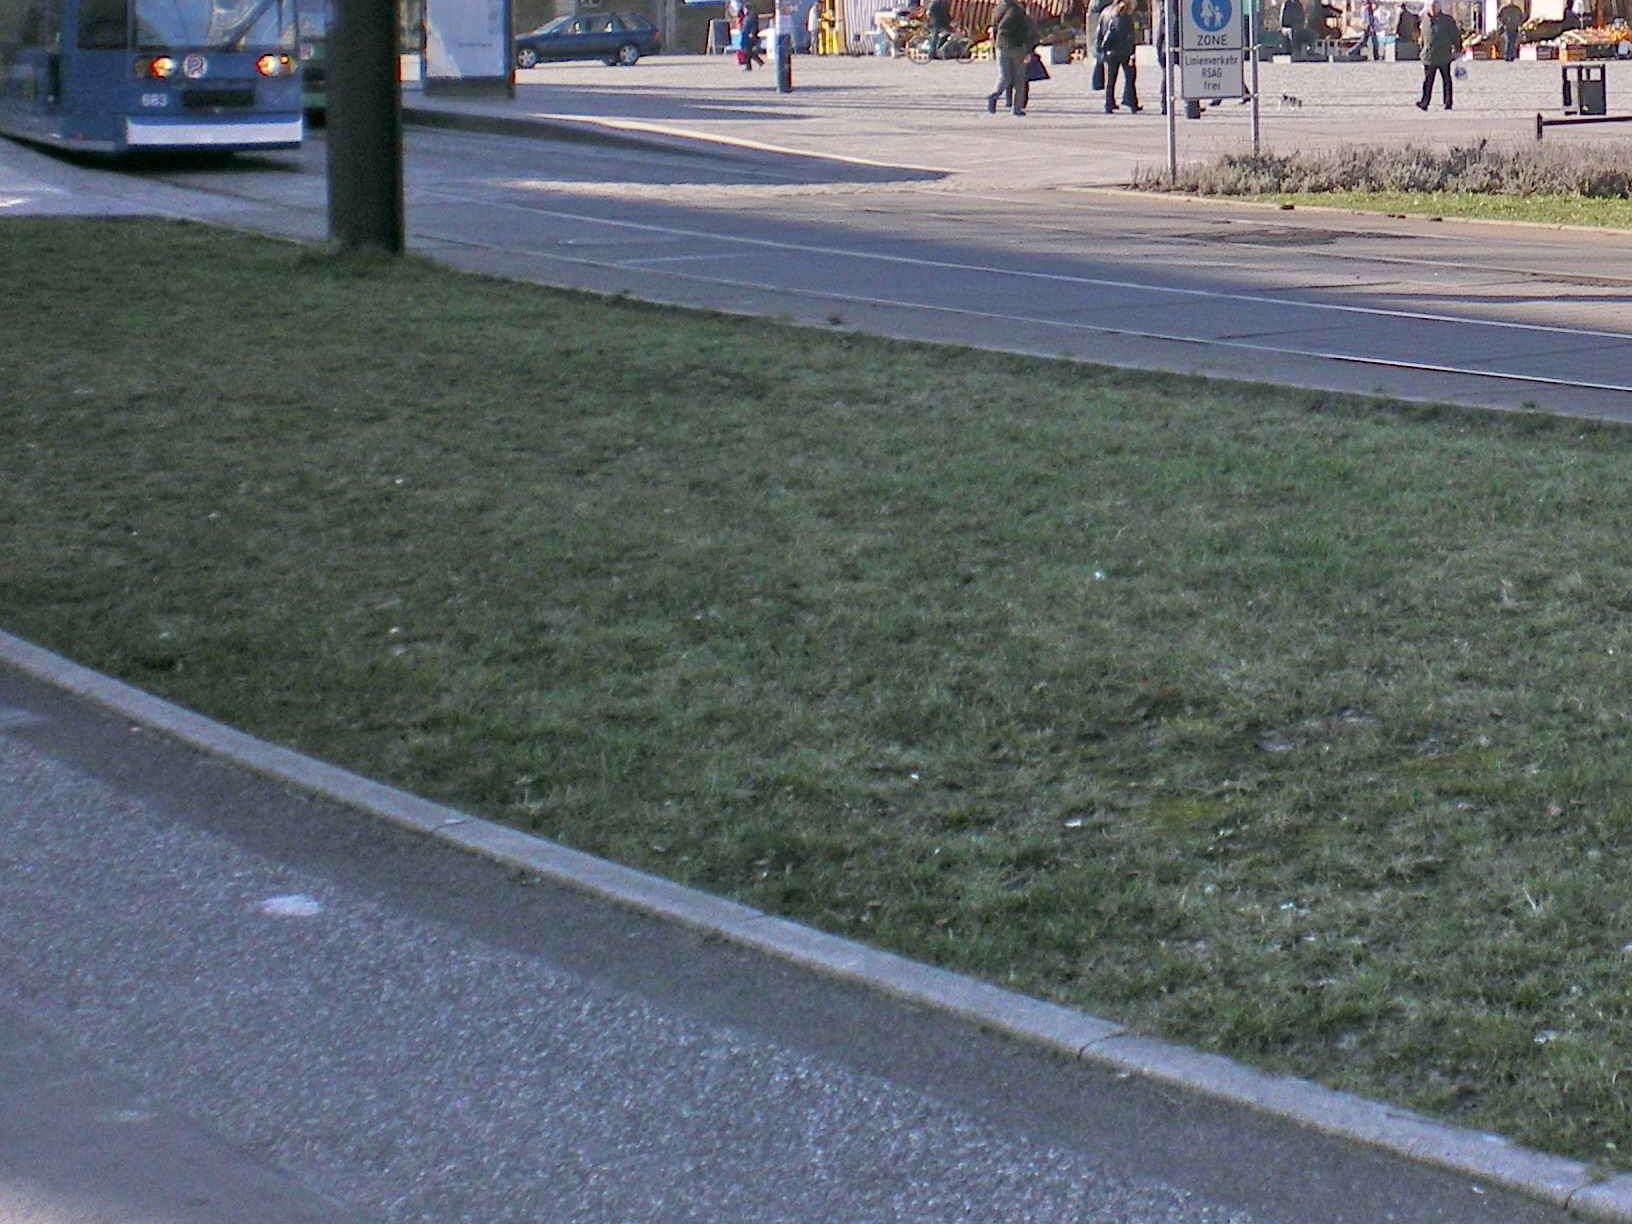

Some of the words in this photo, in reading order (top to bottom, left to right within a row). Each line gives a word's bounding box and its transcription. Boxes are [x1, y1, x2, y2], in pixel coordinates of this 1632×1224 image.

[1197, 34, 1228, 46] ZONE
[1185, 55, 1238, 66] Linienverkehr
[1202, 67, 1223, 78] RSAG
[1203, 80, 1221, 91] frei
